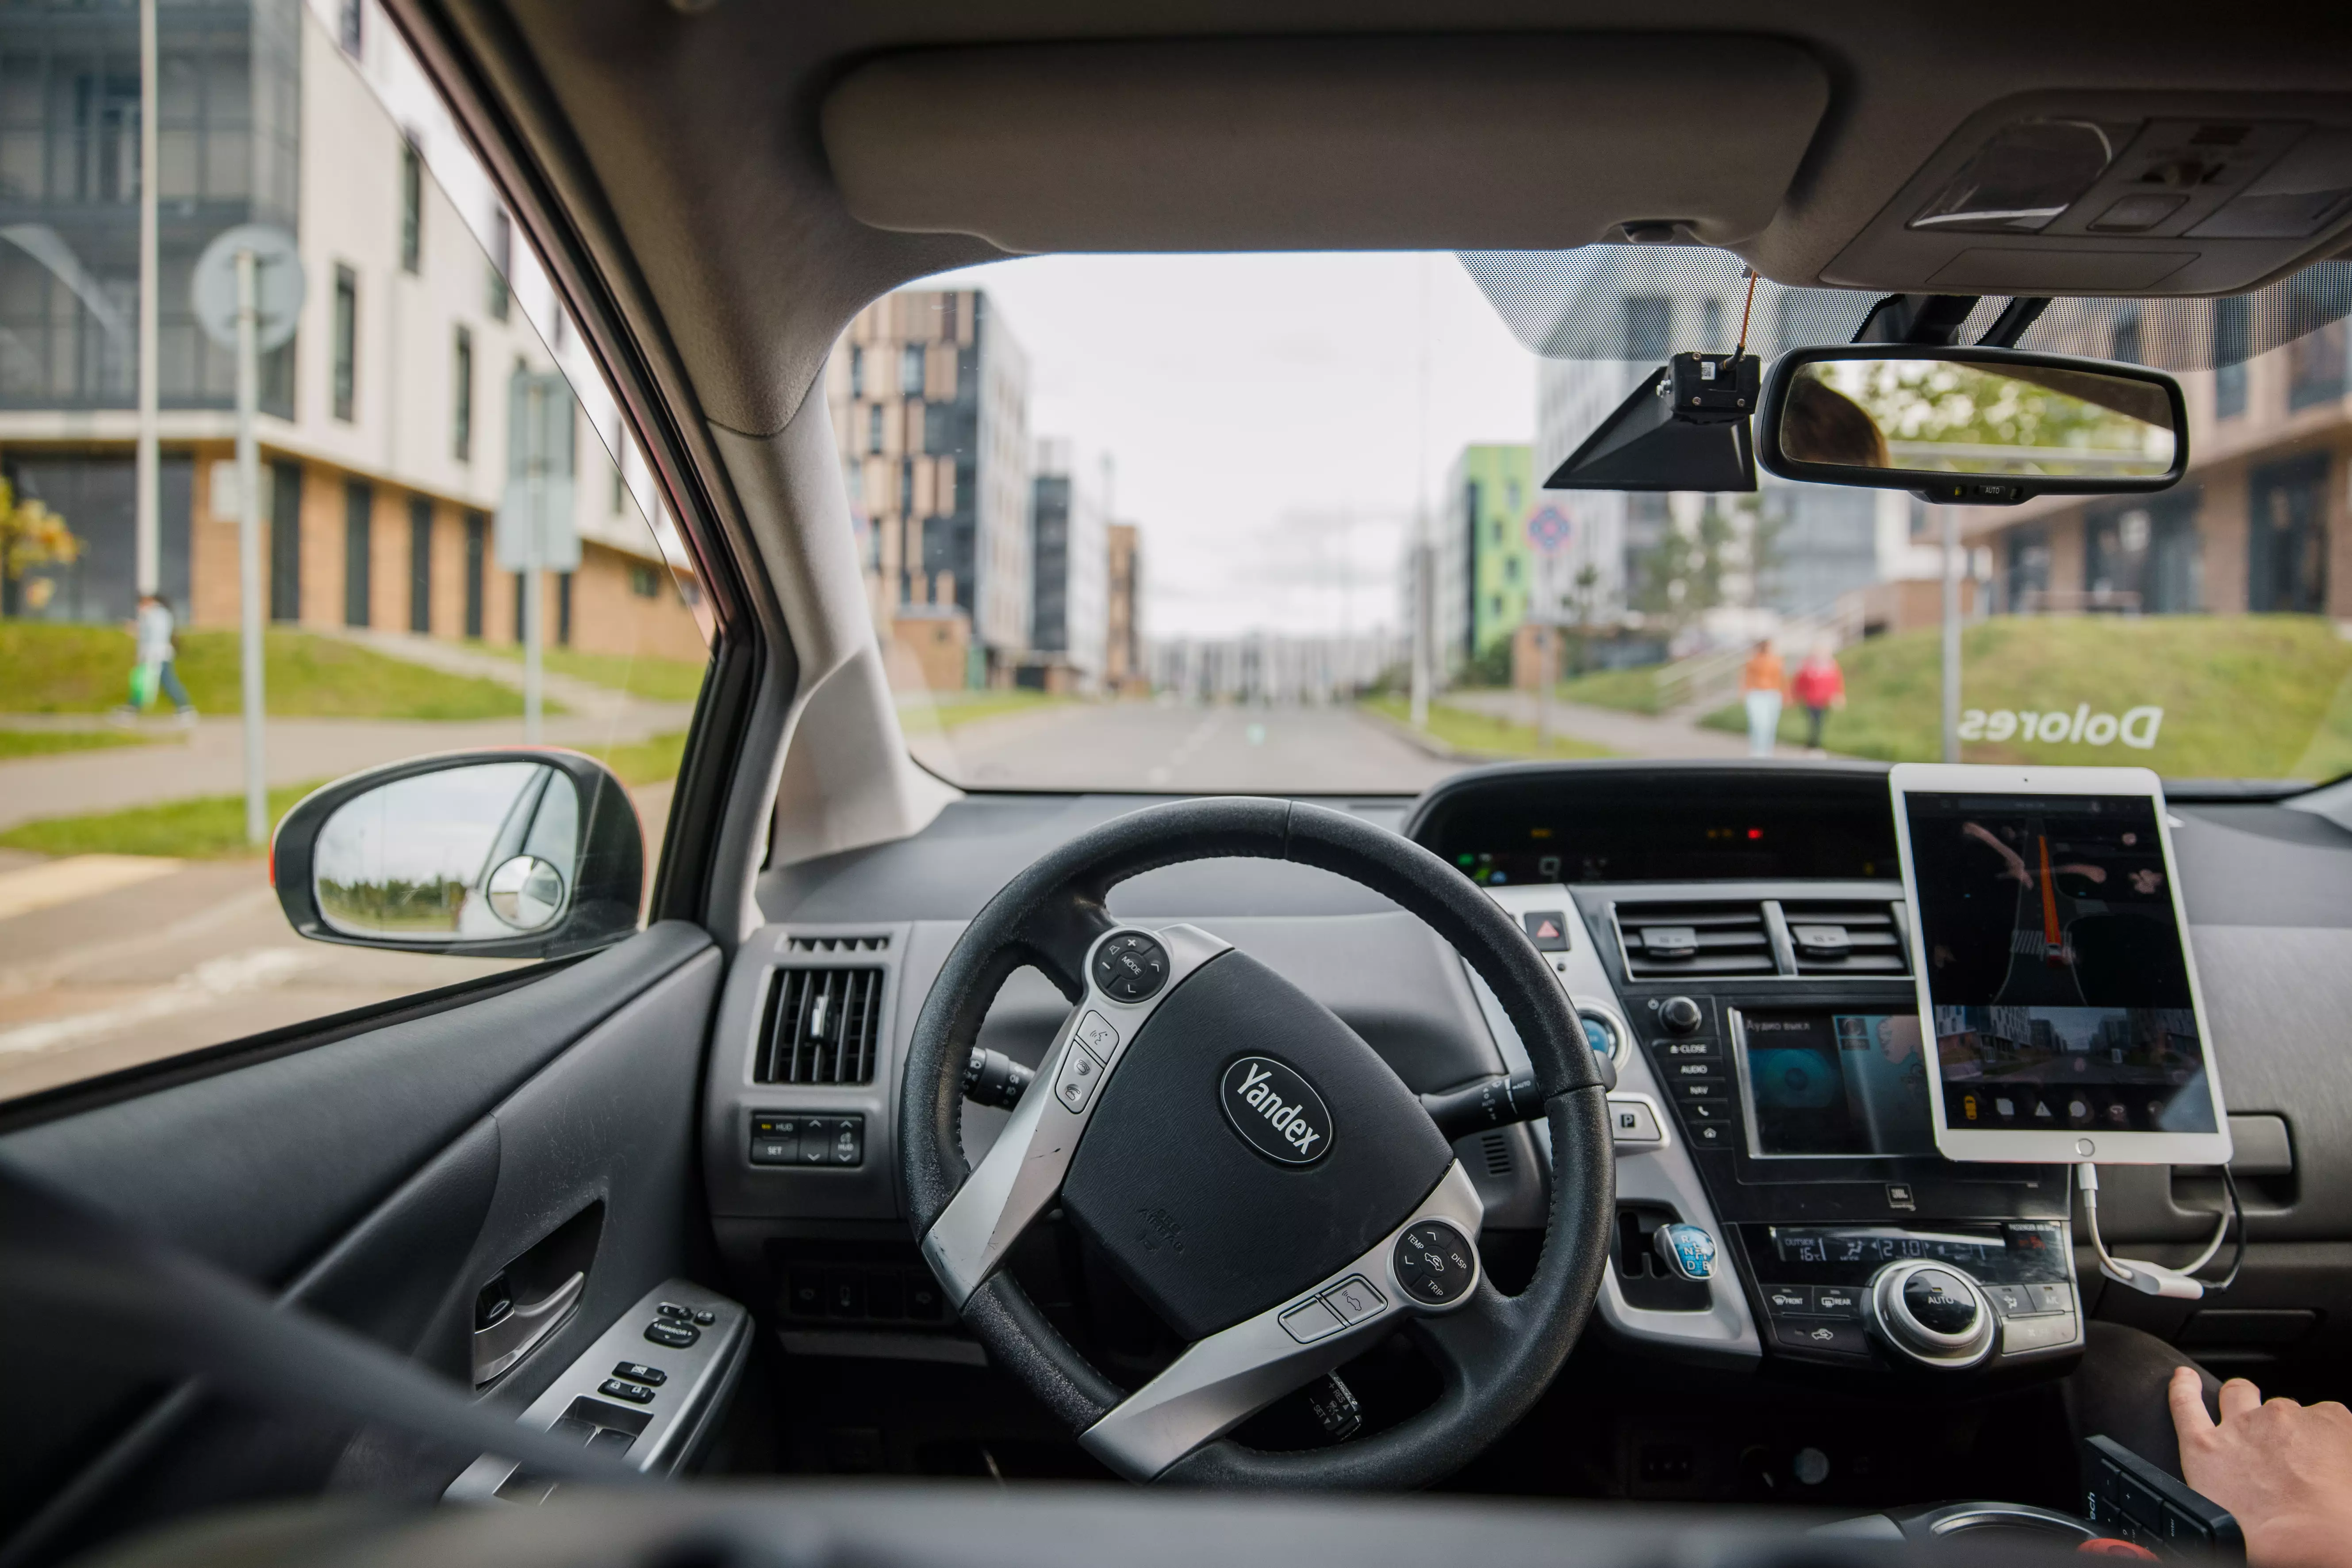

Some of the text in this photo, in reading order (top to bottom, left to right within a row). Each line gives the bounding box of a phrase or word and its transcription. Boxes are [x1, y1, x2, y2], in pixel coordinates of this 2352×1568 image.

[1121, 956, 1142, 975] MODE
[1681, 1044, 1707, 1054] CLOSE
[1681, 1065, 1707, 1074] AUDIO
[1237, 1063, 1320, 1155] Yandex
[775, 1123, 794, 1131] HUD
[767, 1146, 782, 1155] SET
[1407, 1233, 1424, 1250] TEMP
[1684, 1247, 1693, 1256] N
[1451, 1253, 1467, 1270] DISP
[1687, 1261, 1696, 1270] D
[1427, 1280, 1444, 1297] TRIP
[1928, 1295, 1954, 1305] AUTO
[658, 1324, 687, 1336] MIRROR
[1333, 1389, 1346, 1403] RES
[1313, 1405, 1326, 1418] SET
